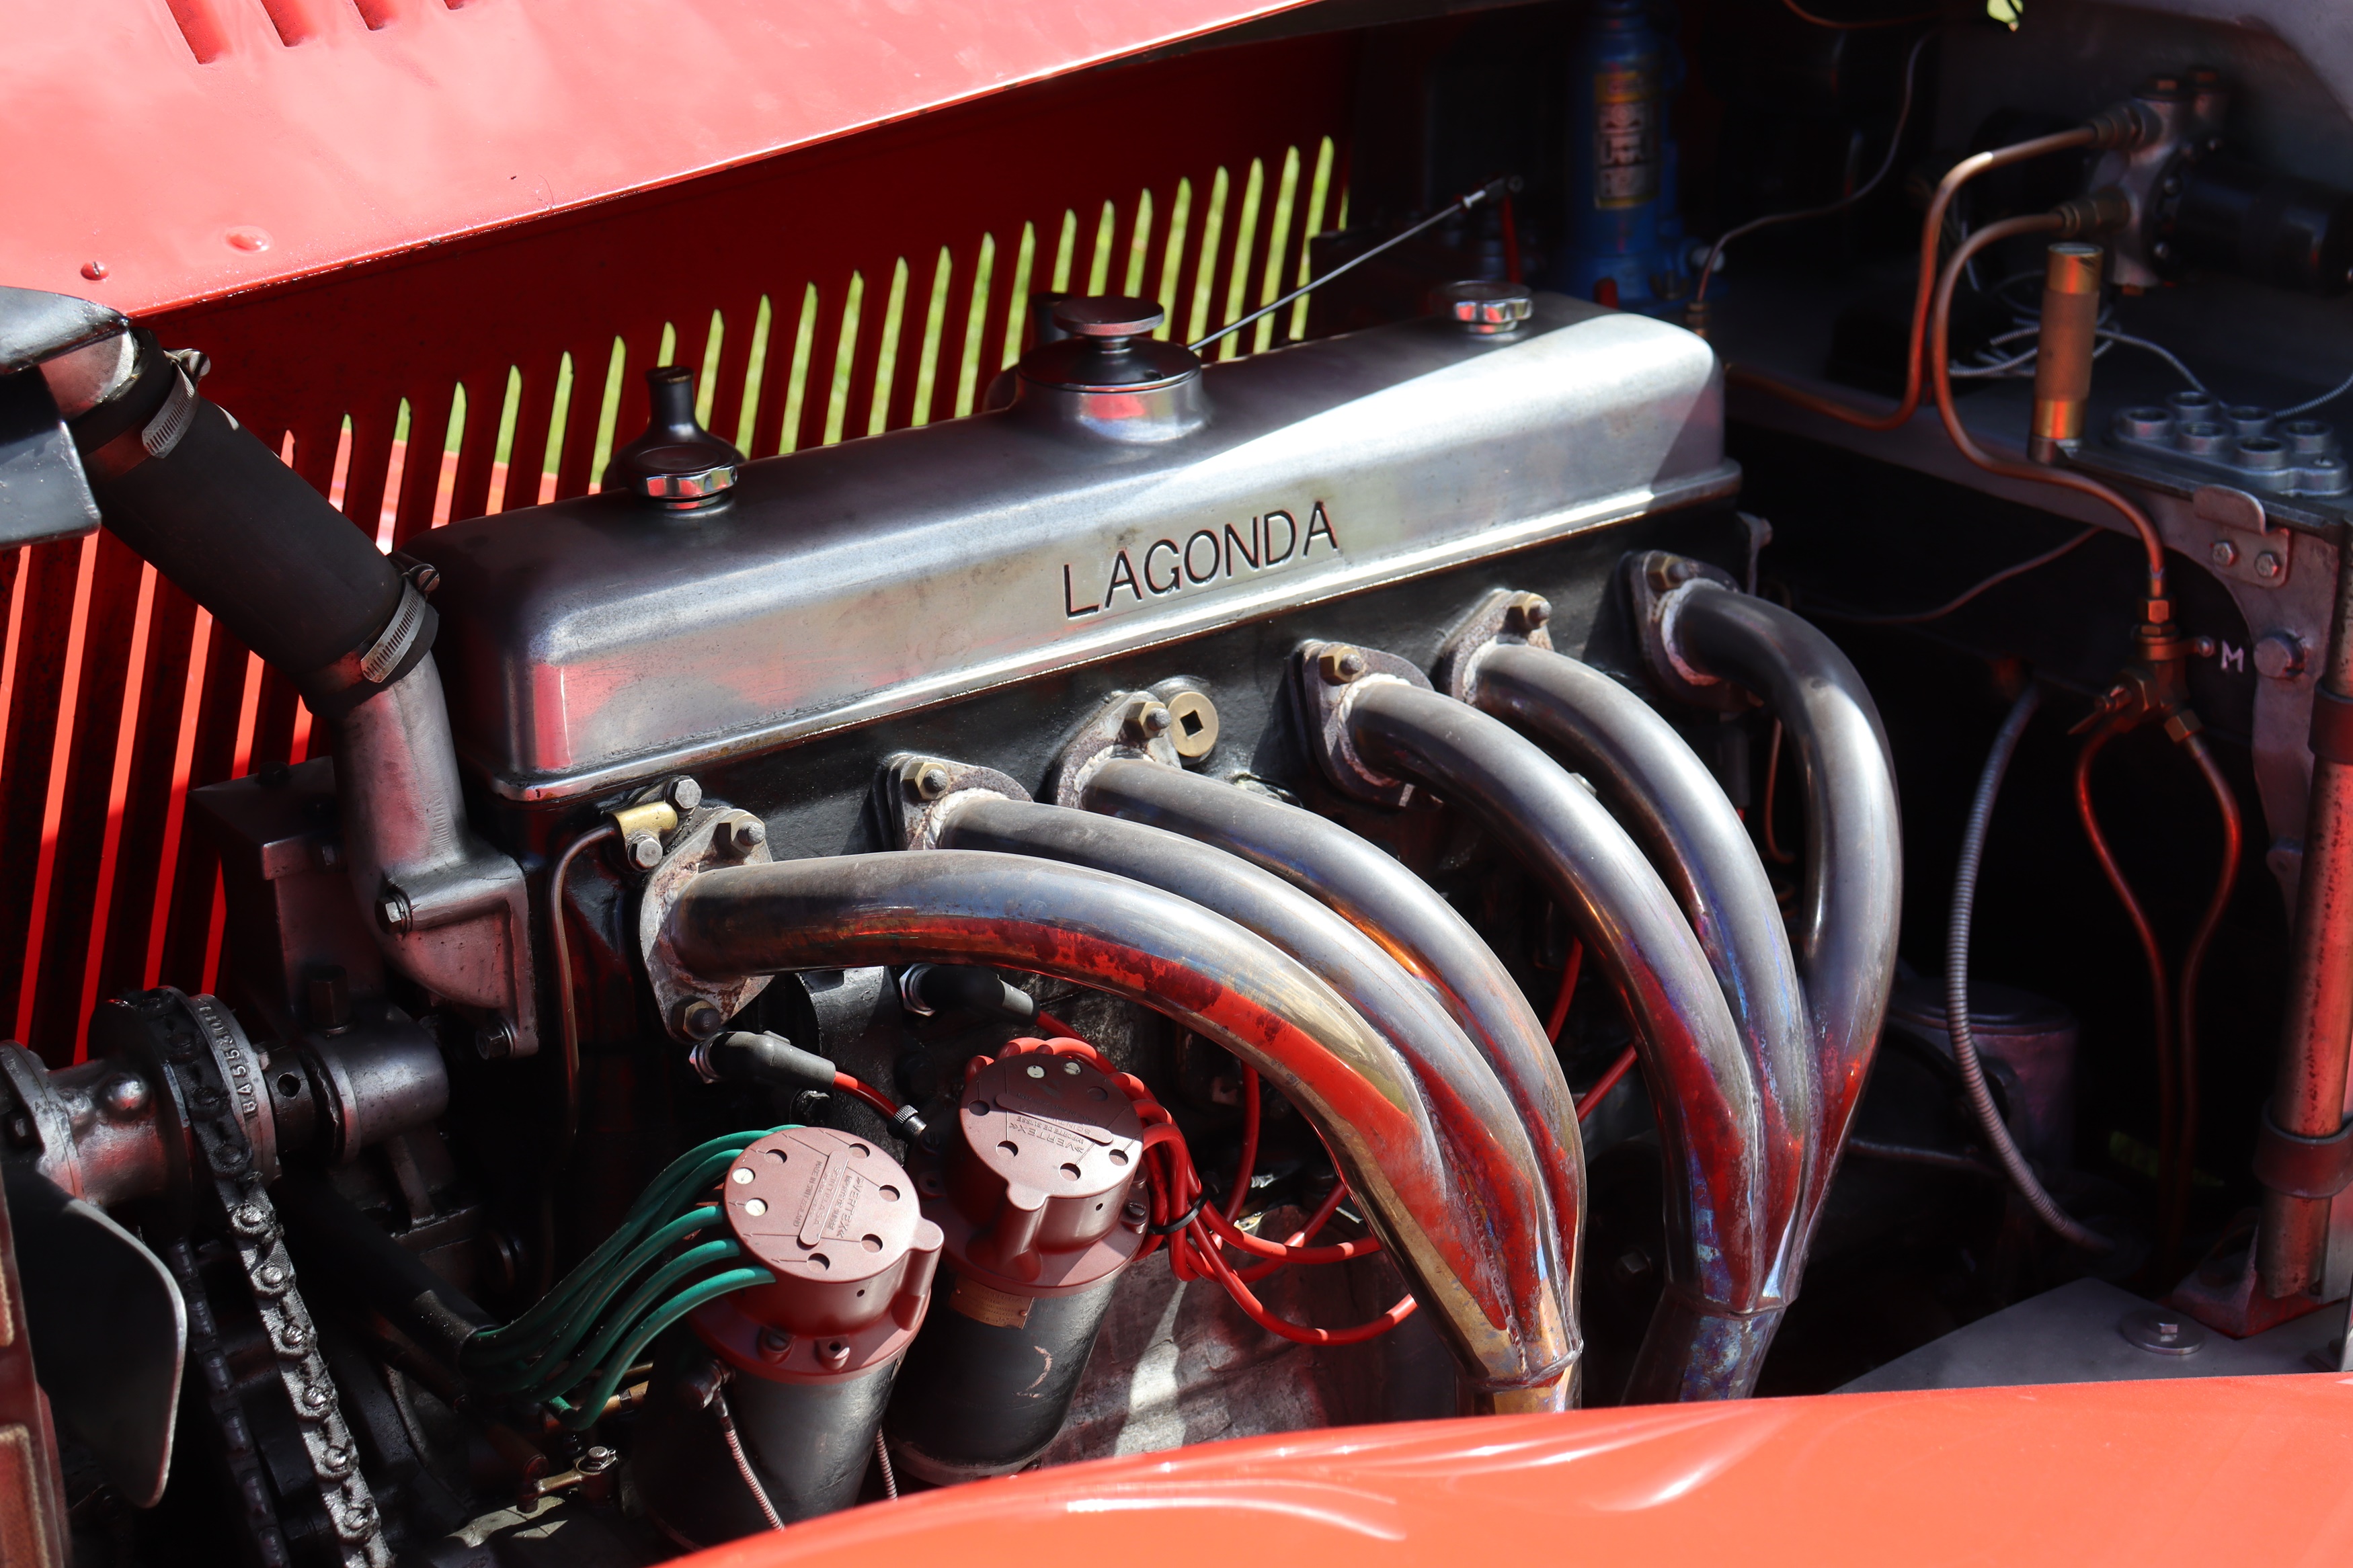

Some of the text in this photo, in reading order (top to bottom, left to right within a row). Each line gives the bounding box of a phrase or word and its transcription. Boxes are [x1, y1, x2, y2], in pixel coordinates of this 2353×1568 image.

[1063, 500, 1338, 620] LAGONDA
[2221, 639, 2244, 673] M
[1016, 1116, 1041, 1128] SUISSE
[812, 1161, 822, 1176] MADE
[793, 1184, 813, 1227] SWITZERLAND
[820, 1167, 841, 1210] SCINTILLA
